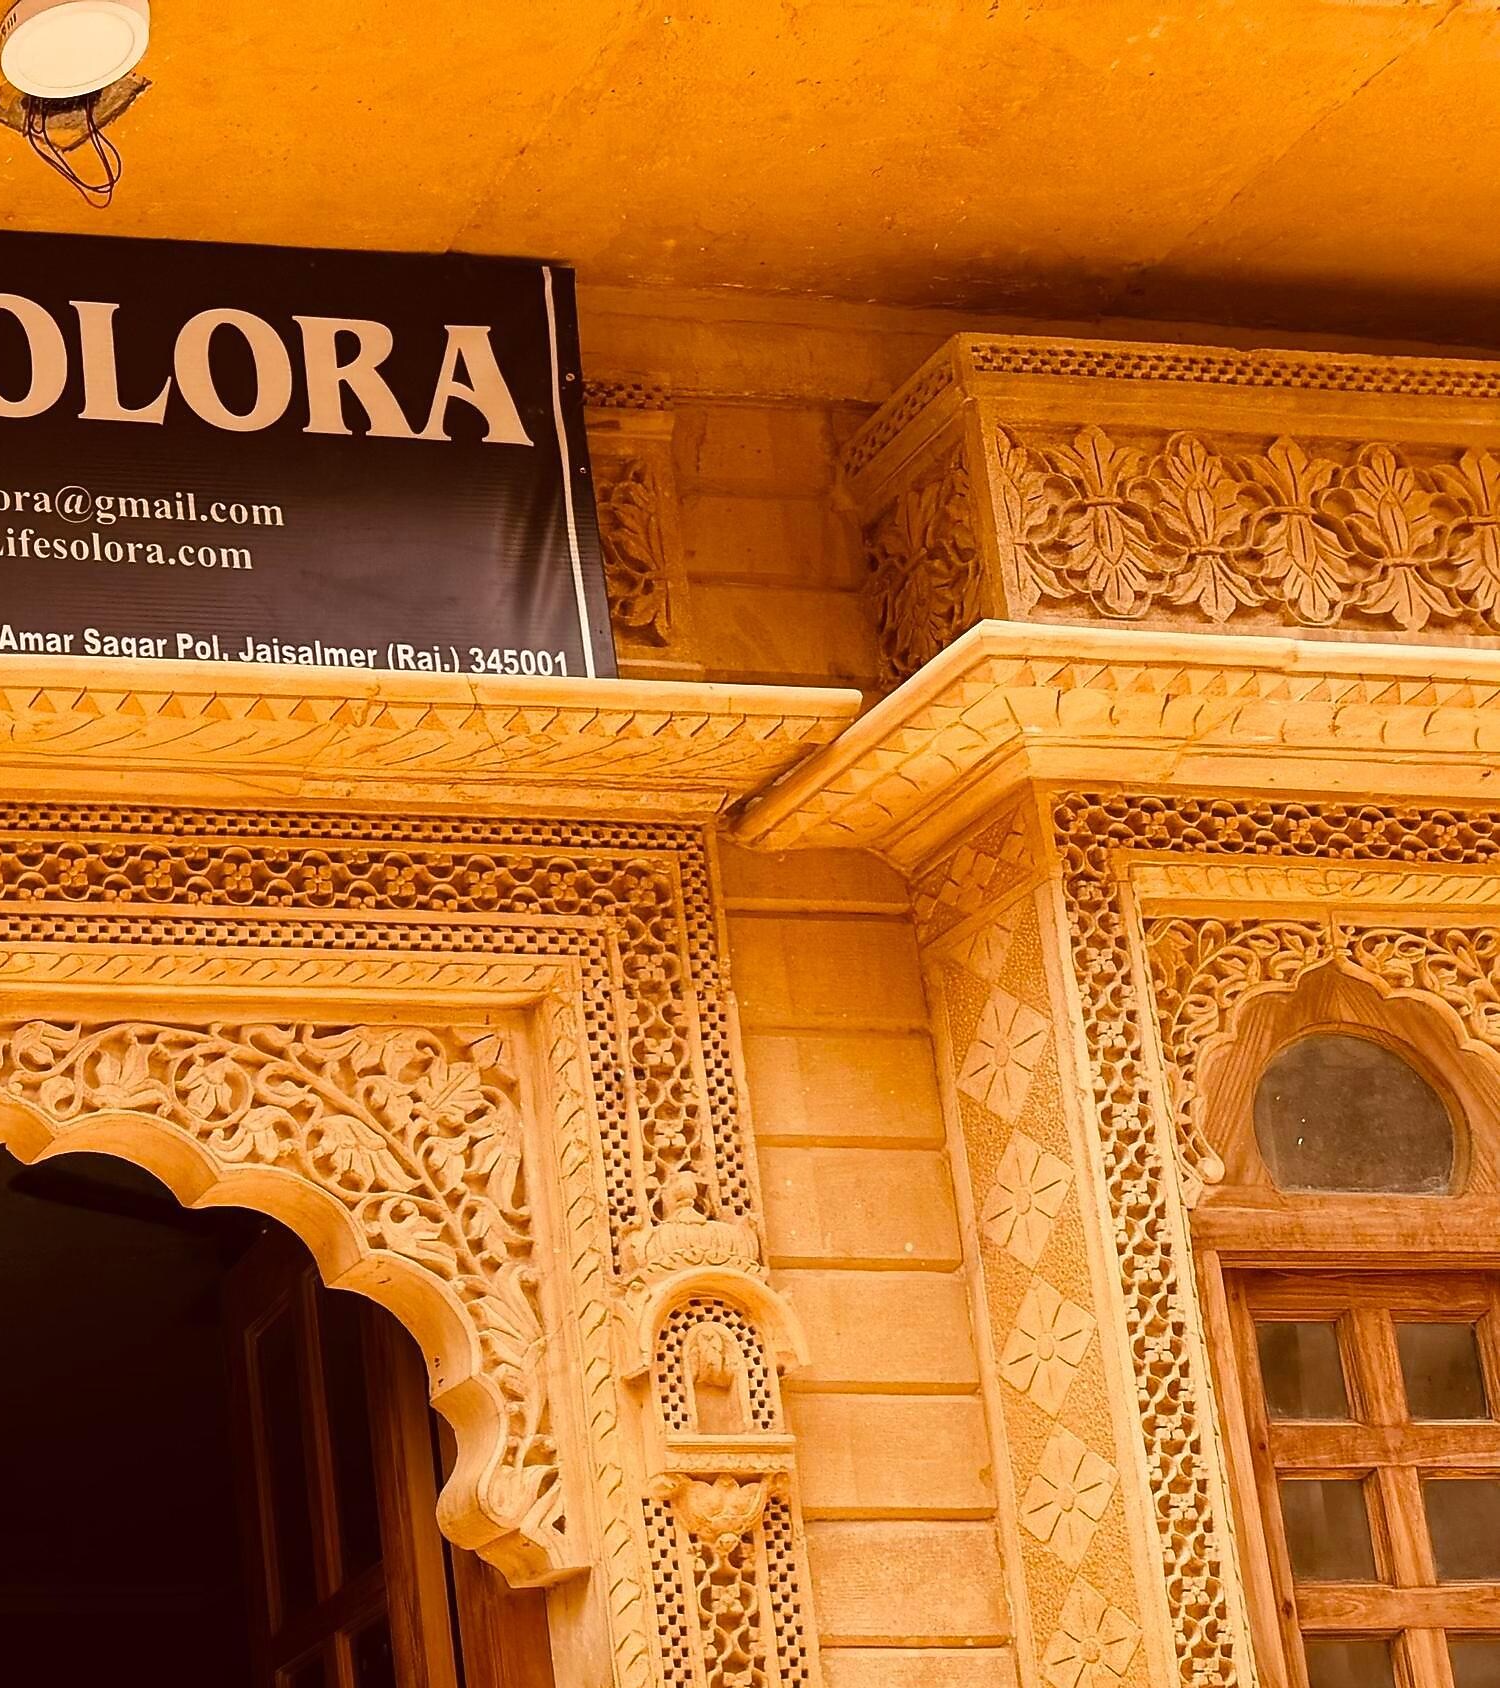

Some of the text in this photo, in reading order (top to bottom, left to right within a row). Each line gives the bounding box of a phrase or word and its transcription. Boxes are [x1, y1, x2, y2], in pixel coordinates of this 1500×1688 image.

[83, 627, 168, 659] Sagar
[238, 636, 377, 669] Jaisalmer
[469, 647, 567, 677] 345001
